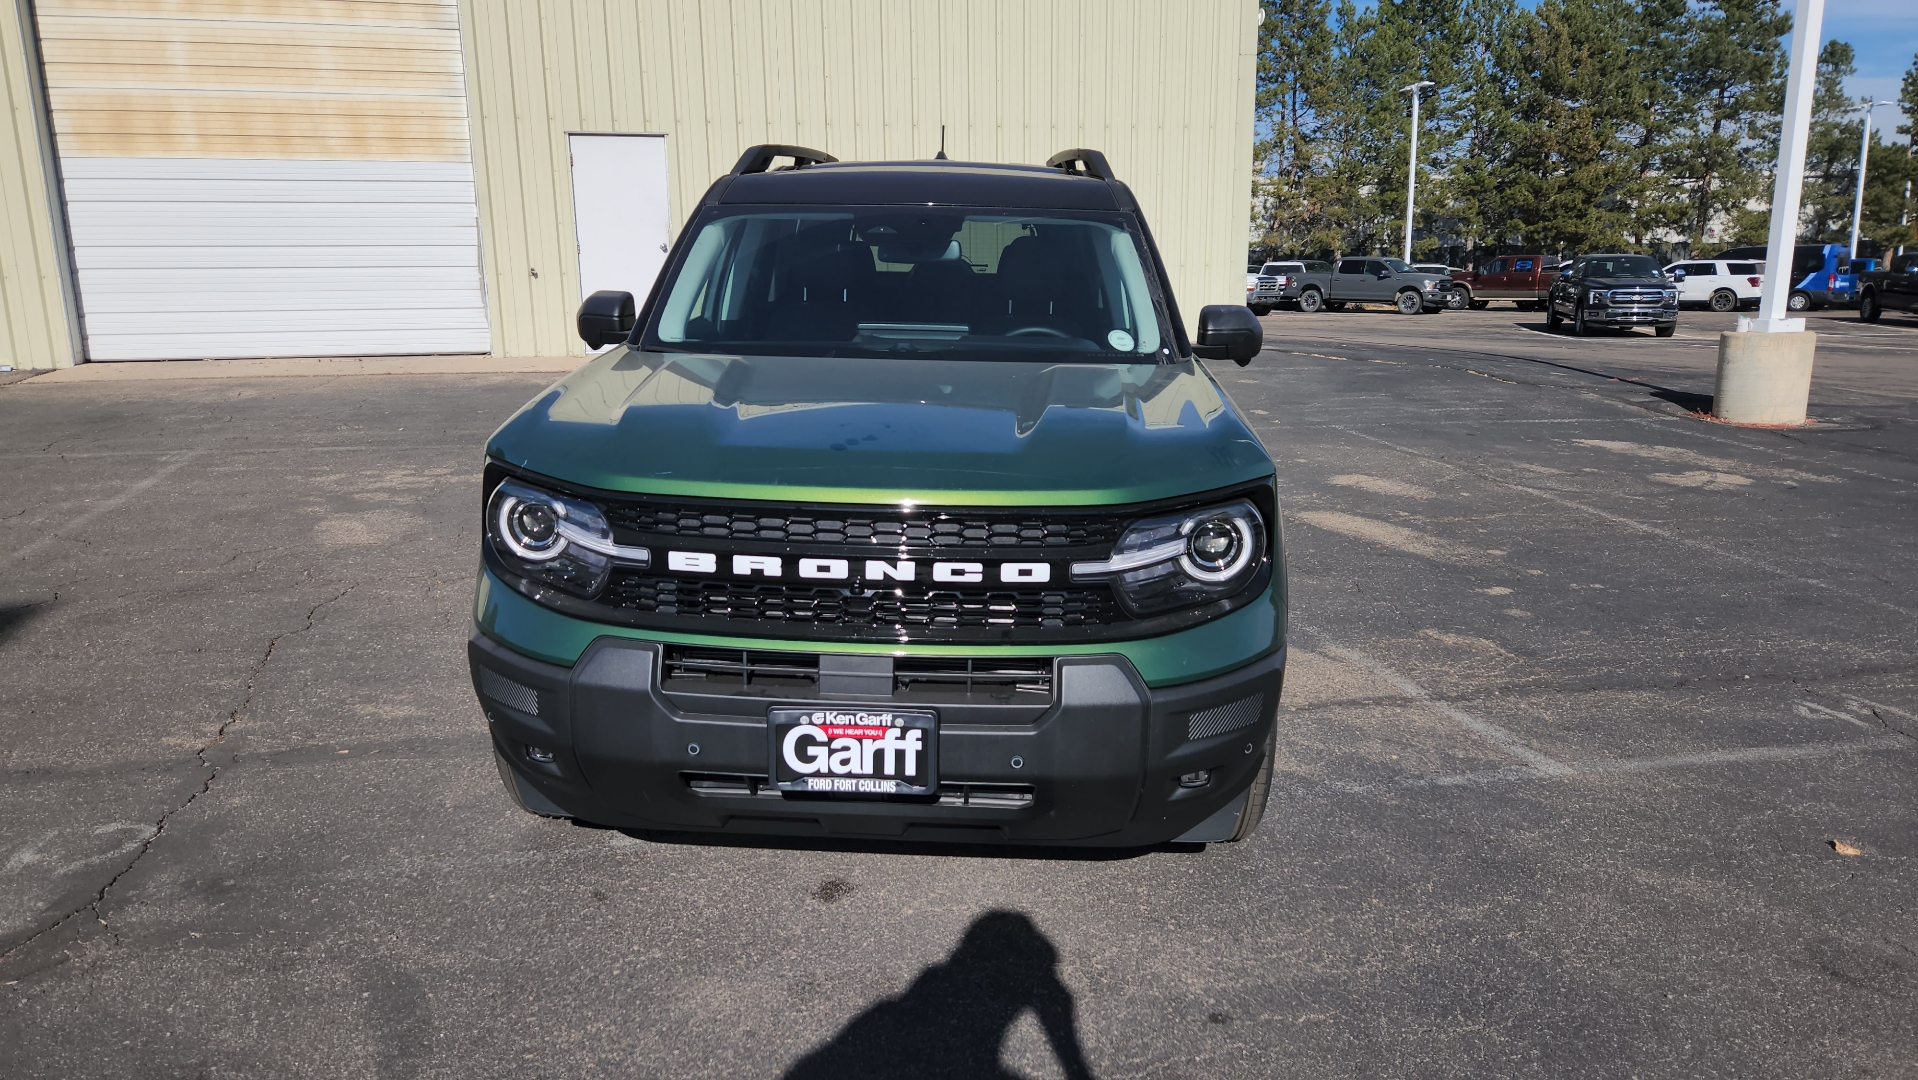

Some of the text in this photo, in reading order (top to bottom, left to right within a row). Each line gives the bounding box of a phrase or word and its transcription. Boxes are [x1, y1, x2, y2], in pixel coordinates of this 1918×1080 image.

[668, 551, 1051, 583] BRONCO
[825, 711, 855, 725] Ken
[855, 712, 893, 726] Garff
[782, 724, 923, 777] Garff
[808, 778, 897, 793] FORD FORT COLLINS
